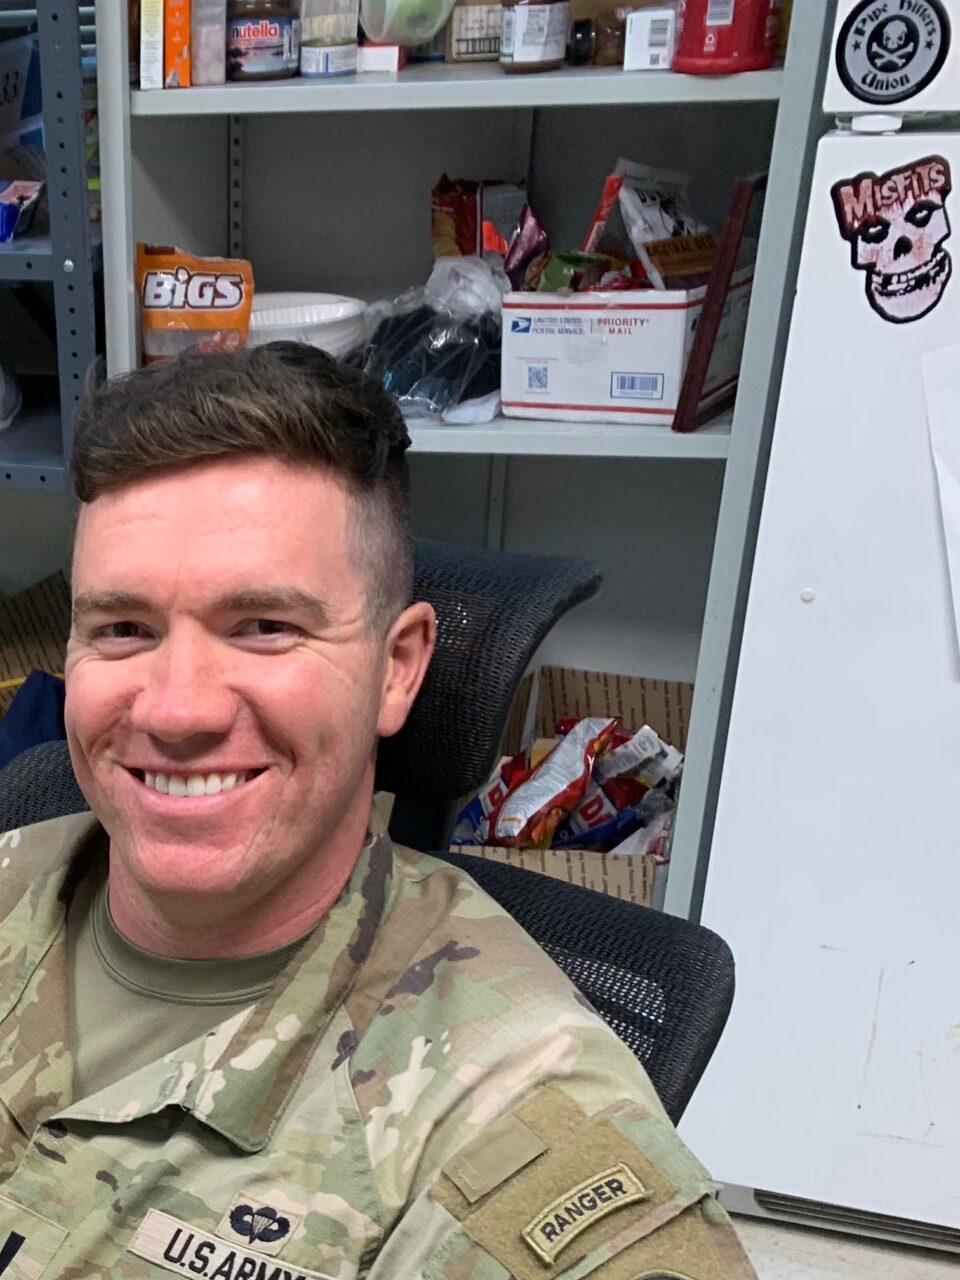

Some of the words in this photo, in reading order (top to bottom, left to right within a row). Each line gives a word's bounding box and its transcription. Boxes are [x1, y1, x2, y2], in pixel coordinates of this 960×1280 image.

[232, 20, 279, 40] nutella
[853, 3, 888, 37] Pipe
[861, 70, 910, 91] Union
[597, 318, 646, 327] PRIORITY
[540, 1178, 627, 1243] RANGER
